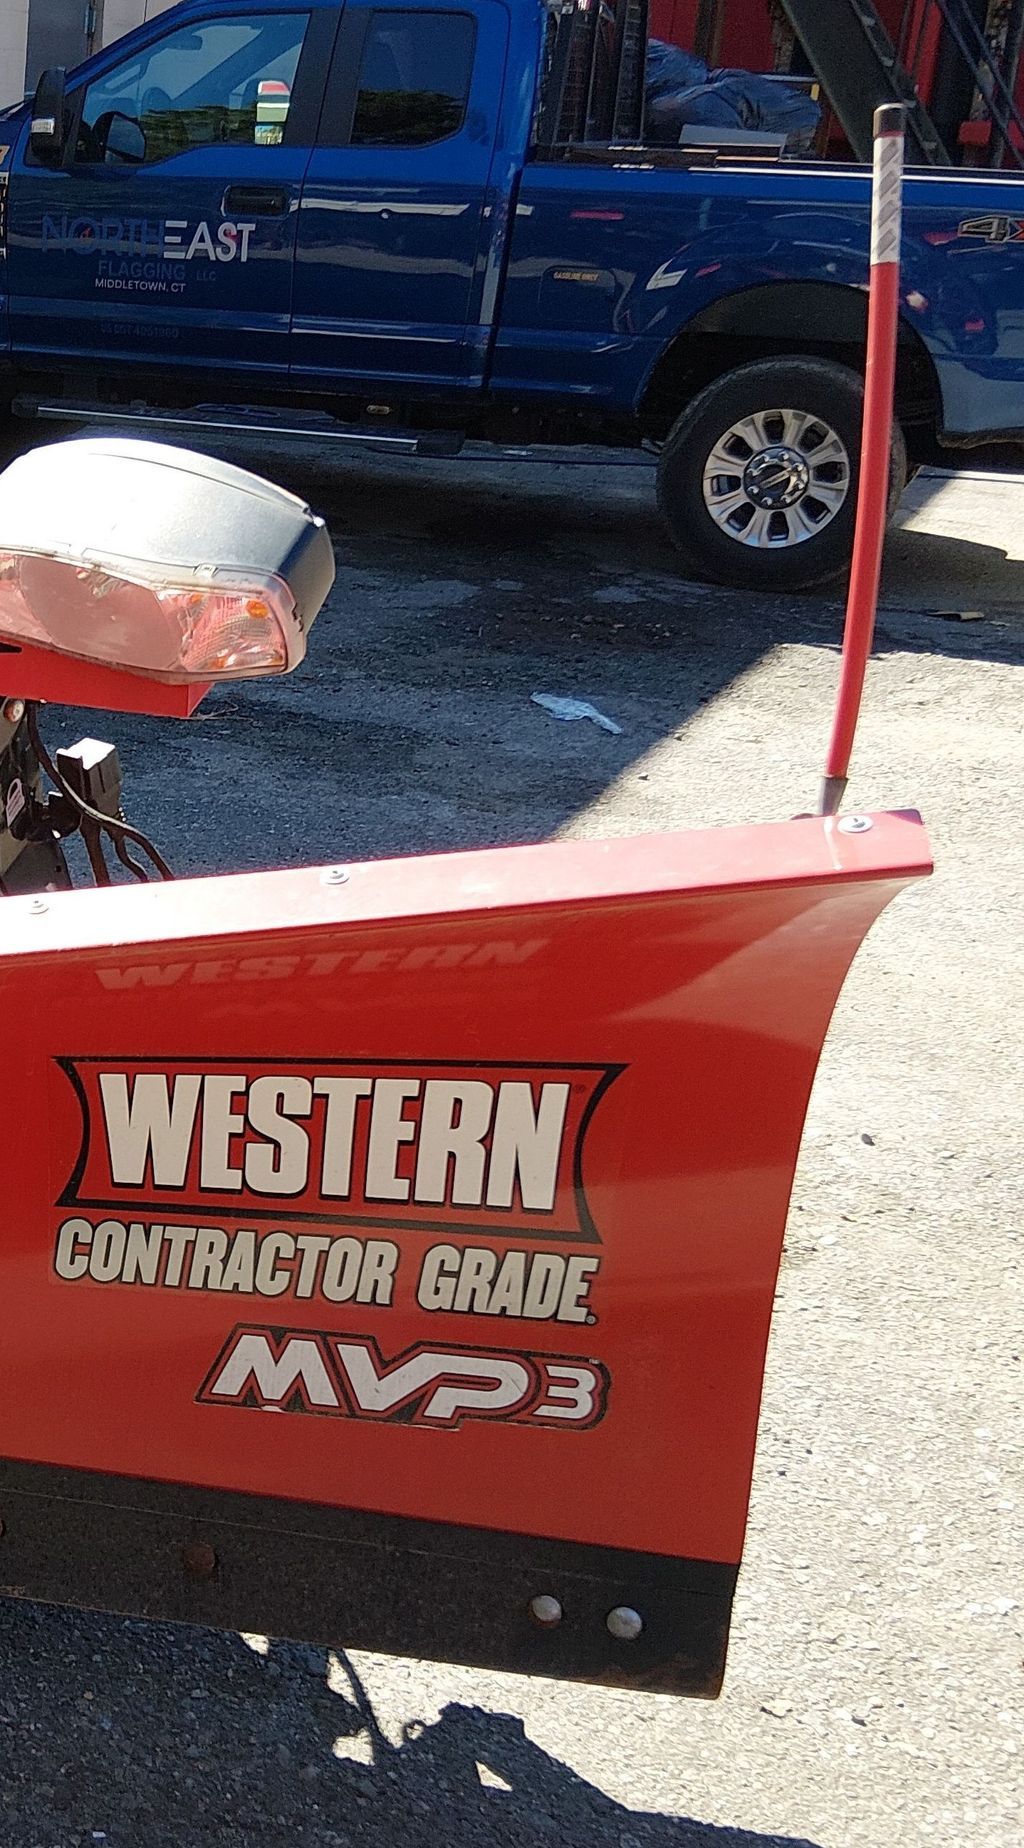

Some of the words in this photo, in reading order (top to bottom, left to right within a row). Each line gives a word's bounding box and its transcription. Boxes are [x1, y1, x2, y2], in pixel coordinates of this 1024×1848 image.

[97, 259, 187, 281] FLAGGING
[170, 283, 187, 293] CT
[99, 1071, 573, 1211] WESTERN
[54, 1219, 399, 1306] CONTRACTOR
